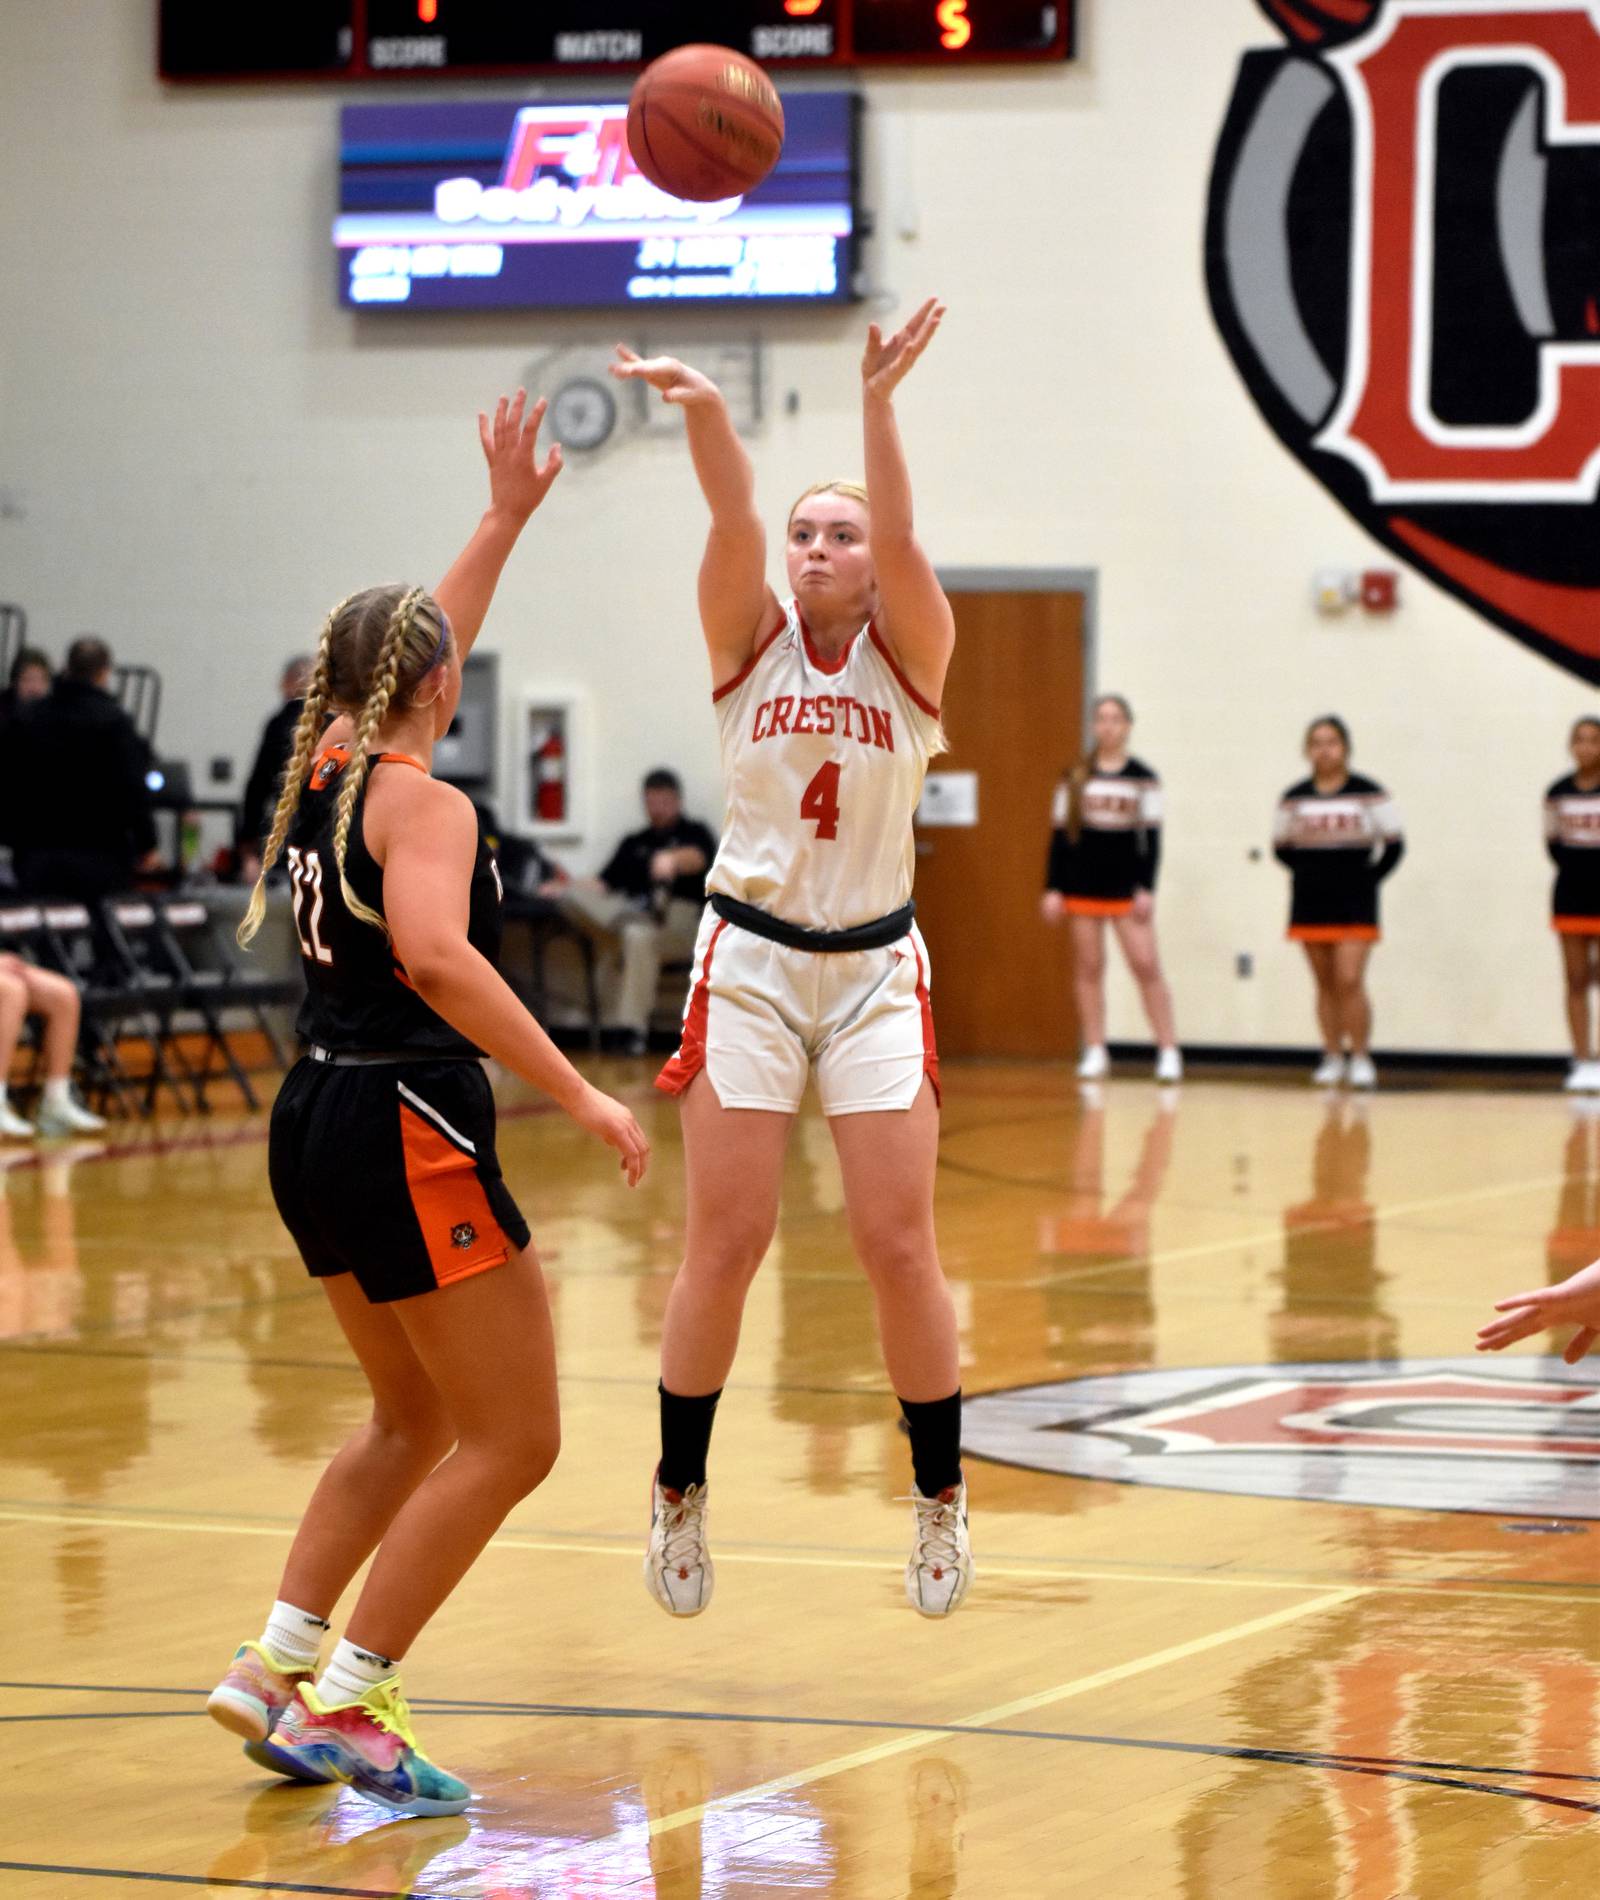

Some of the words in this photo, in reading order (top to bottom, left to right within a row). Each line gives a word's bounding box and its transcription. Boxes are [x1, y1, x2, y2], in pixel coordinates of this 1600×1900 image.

[371, 36, 444, 68] SCORE
[556, 30, 642, 61] MATCH
[753, 24, 832, 57] SCORE
[752, 695, 894, 753] CRESTON
[800, 759, 841, 841] 4
[287, 846, 334, 967] 22
